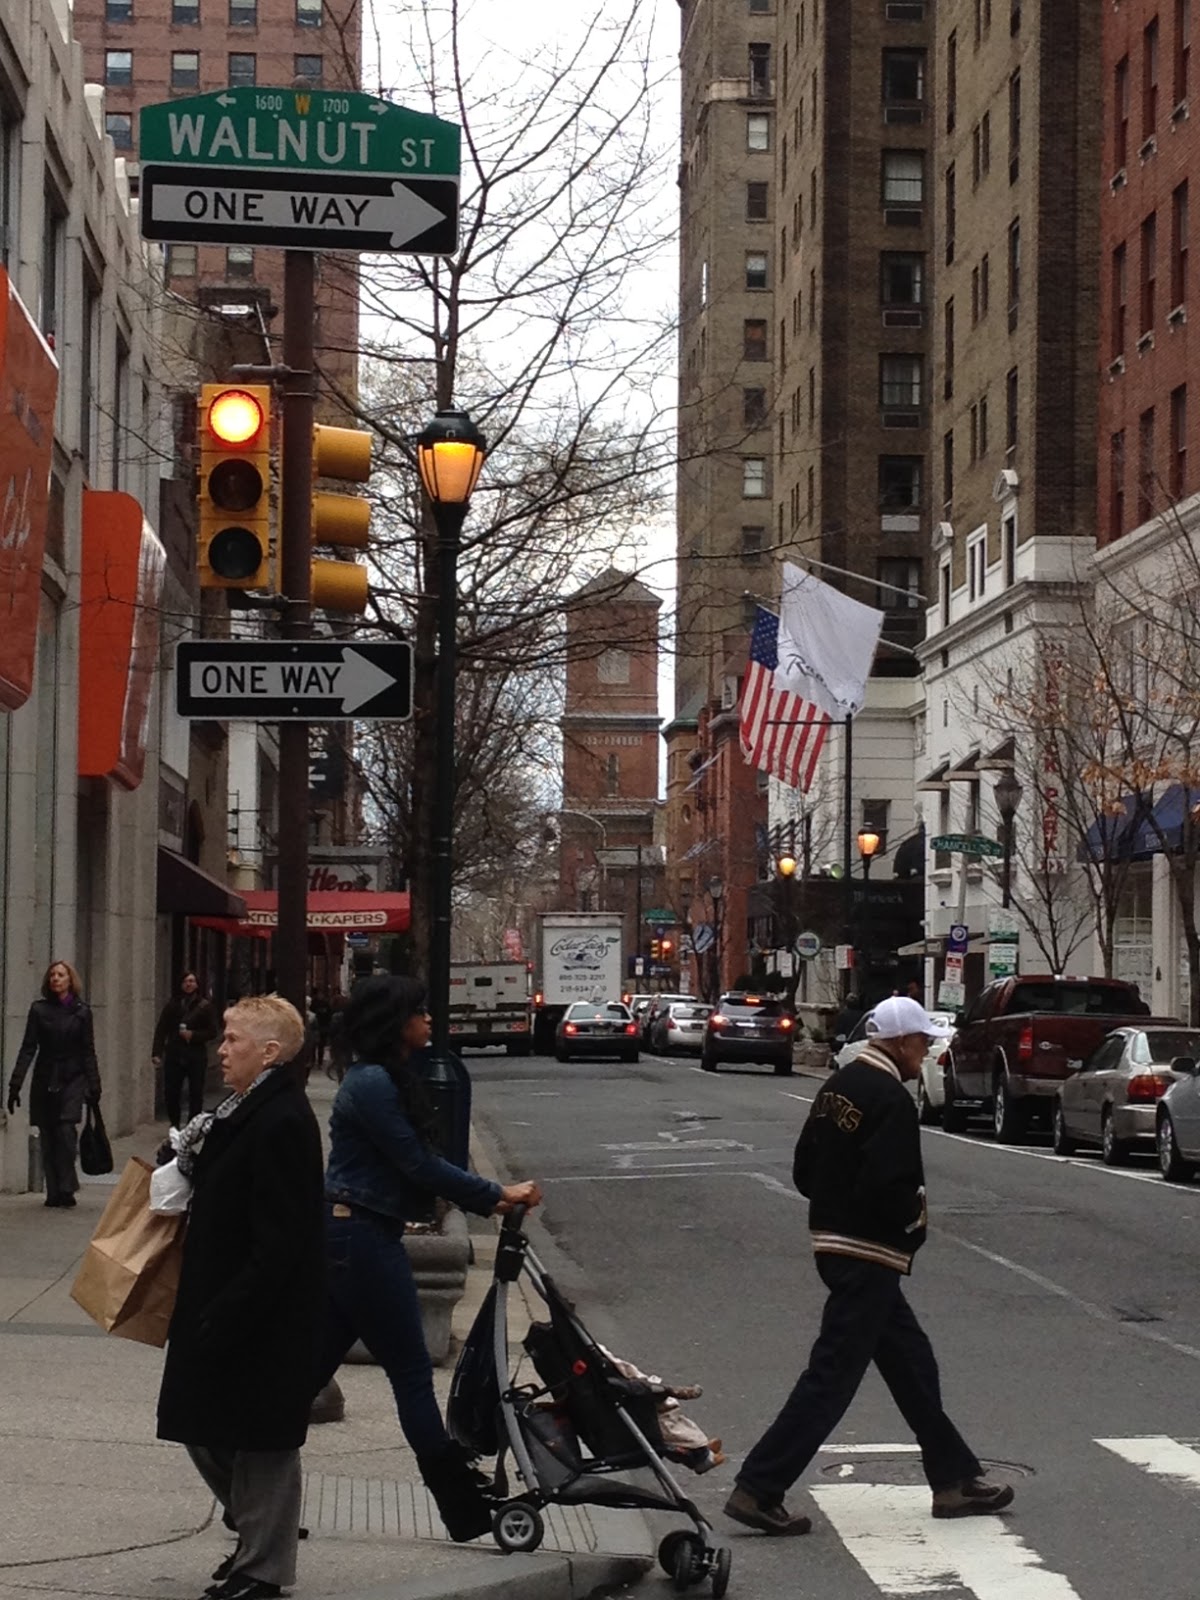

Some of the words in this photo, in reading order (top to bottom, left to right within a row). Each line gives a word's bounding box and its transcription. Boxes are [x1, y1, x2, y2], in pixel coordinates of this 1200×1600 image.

[255, 94, 283, 111] 1600
[295, 93, 311, 115] W
[322, 98, 349, 115] 1700
[167, 112, 377, 165] WALNUT
[401, 137, 435, 169] ST
[184, 190, 265, 222] ONE
[290, 195, 371, 227] WAY
[202, 665, 268, 694] ONE
[281, 666, 341, 694] WAY
[321, 912, 385, 925] KAPERS
